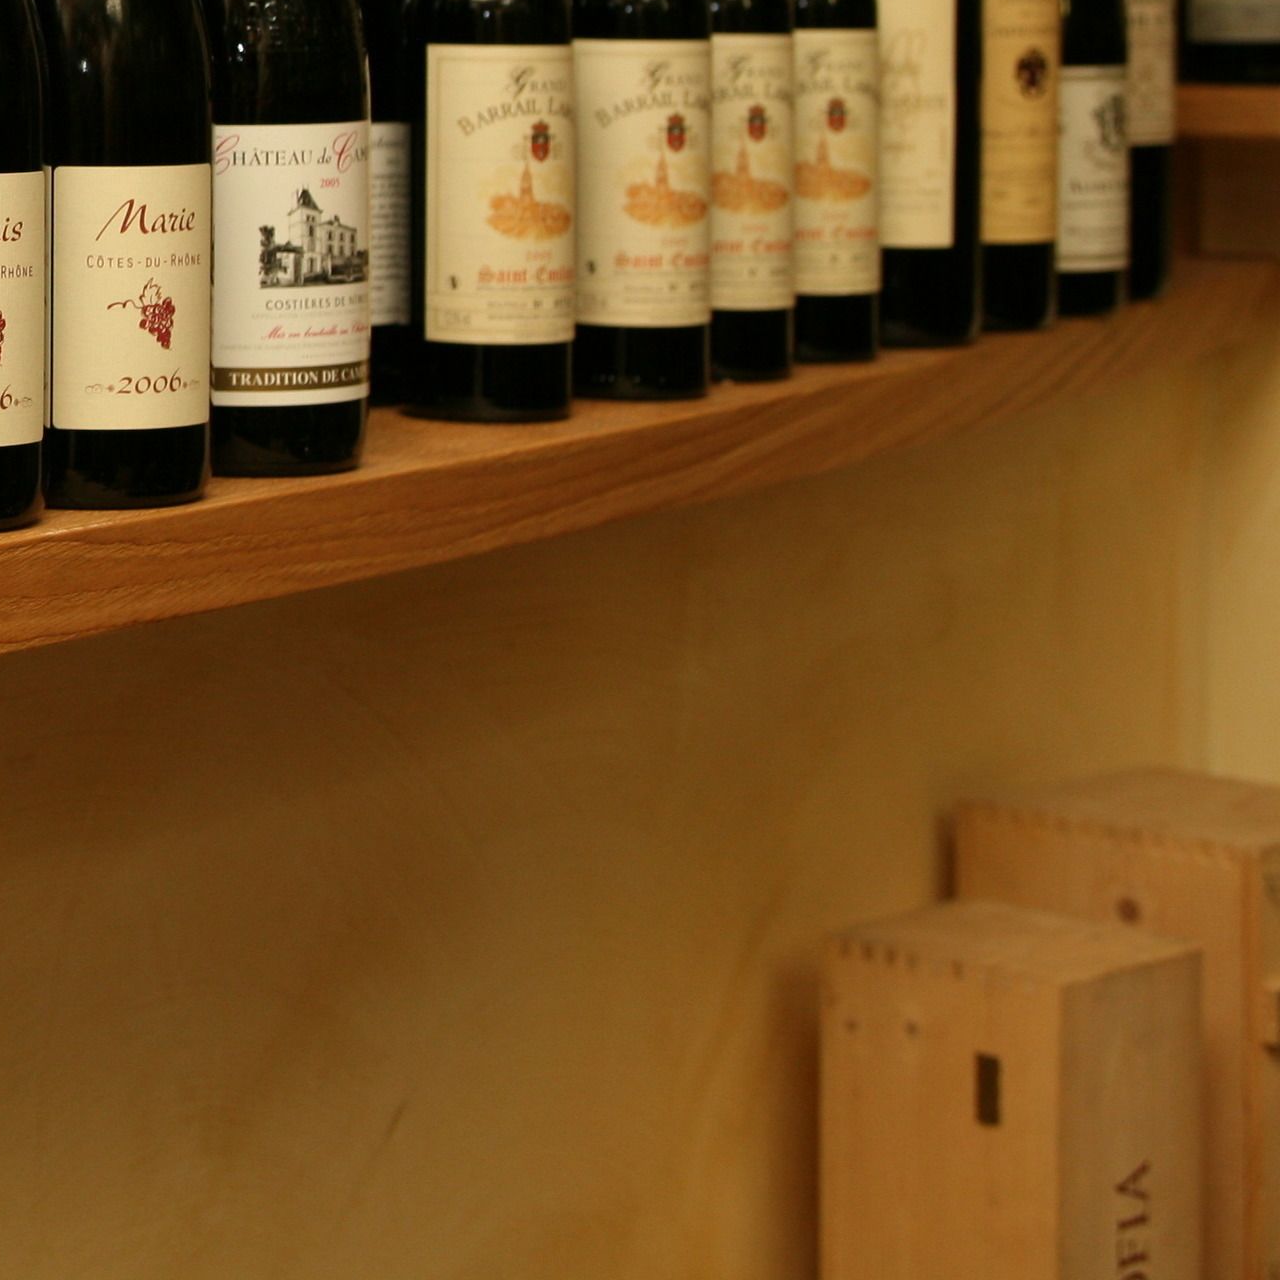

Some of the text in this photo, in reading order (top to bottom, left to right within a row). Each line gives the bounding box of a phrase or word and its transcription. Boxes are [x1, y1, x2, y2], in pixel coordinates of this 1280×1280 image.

[95, 198, 197, 242] Marie
[116, 367, 182, 395] 2006
[228, 370, 319, 387] TRADITION
[322, 369, 338, 385] DE
